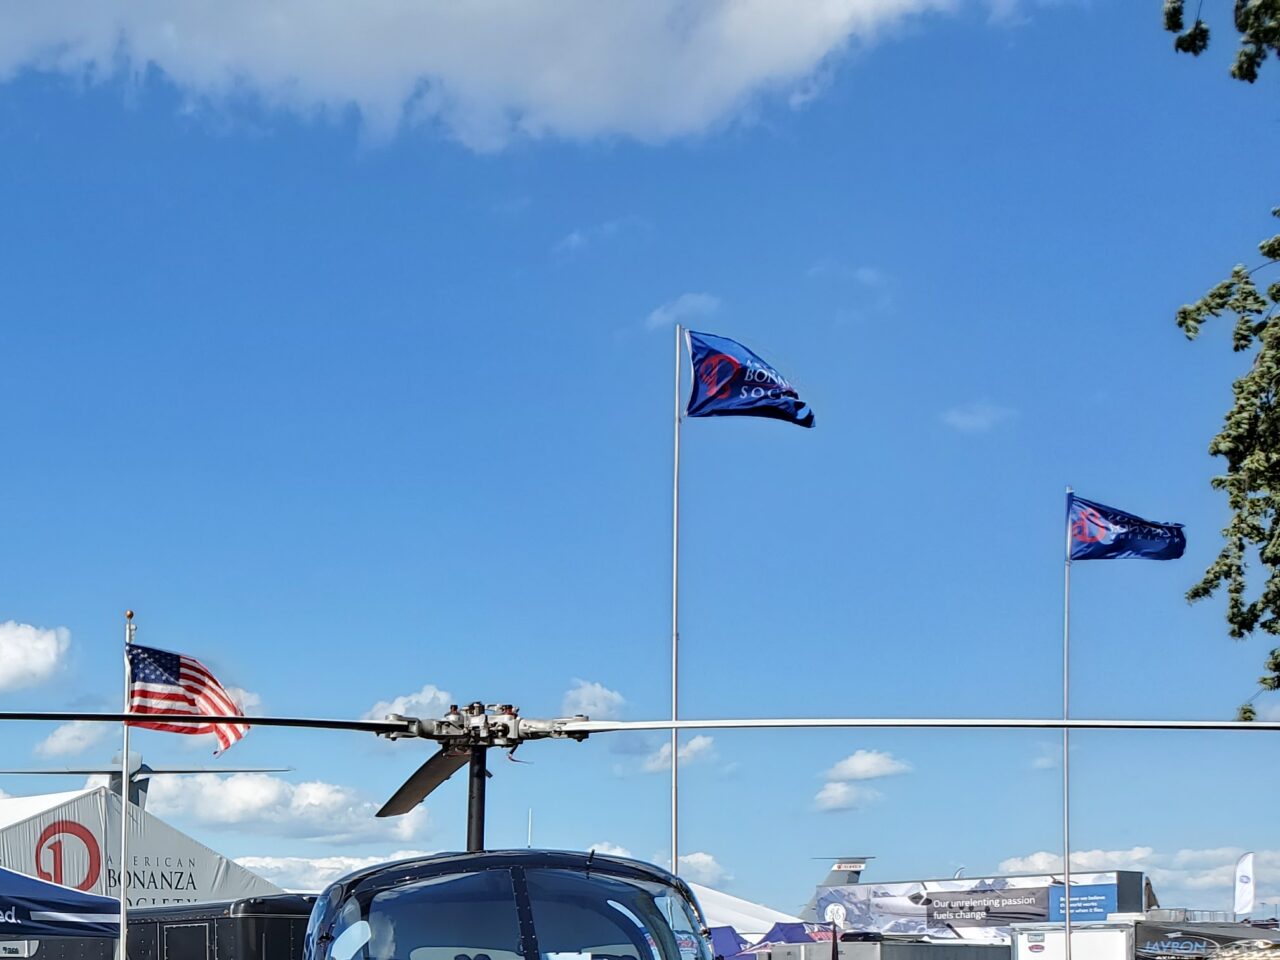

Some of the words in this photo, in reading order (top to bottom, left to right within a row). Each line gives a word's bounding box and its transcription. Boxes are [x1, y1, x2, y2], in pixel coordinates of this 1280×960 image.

[106, 854, 196, 868] AERICAN
[933, 899, 949, 908] Our
[951, 898, 1000, 908] unrelenting
[1001, 896, 1035, 907] passion
[933, 911, 954, 919] fuels
[955, 911, 986, 920] change
